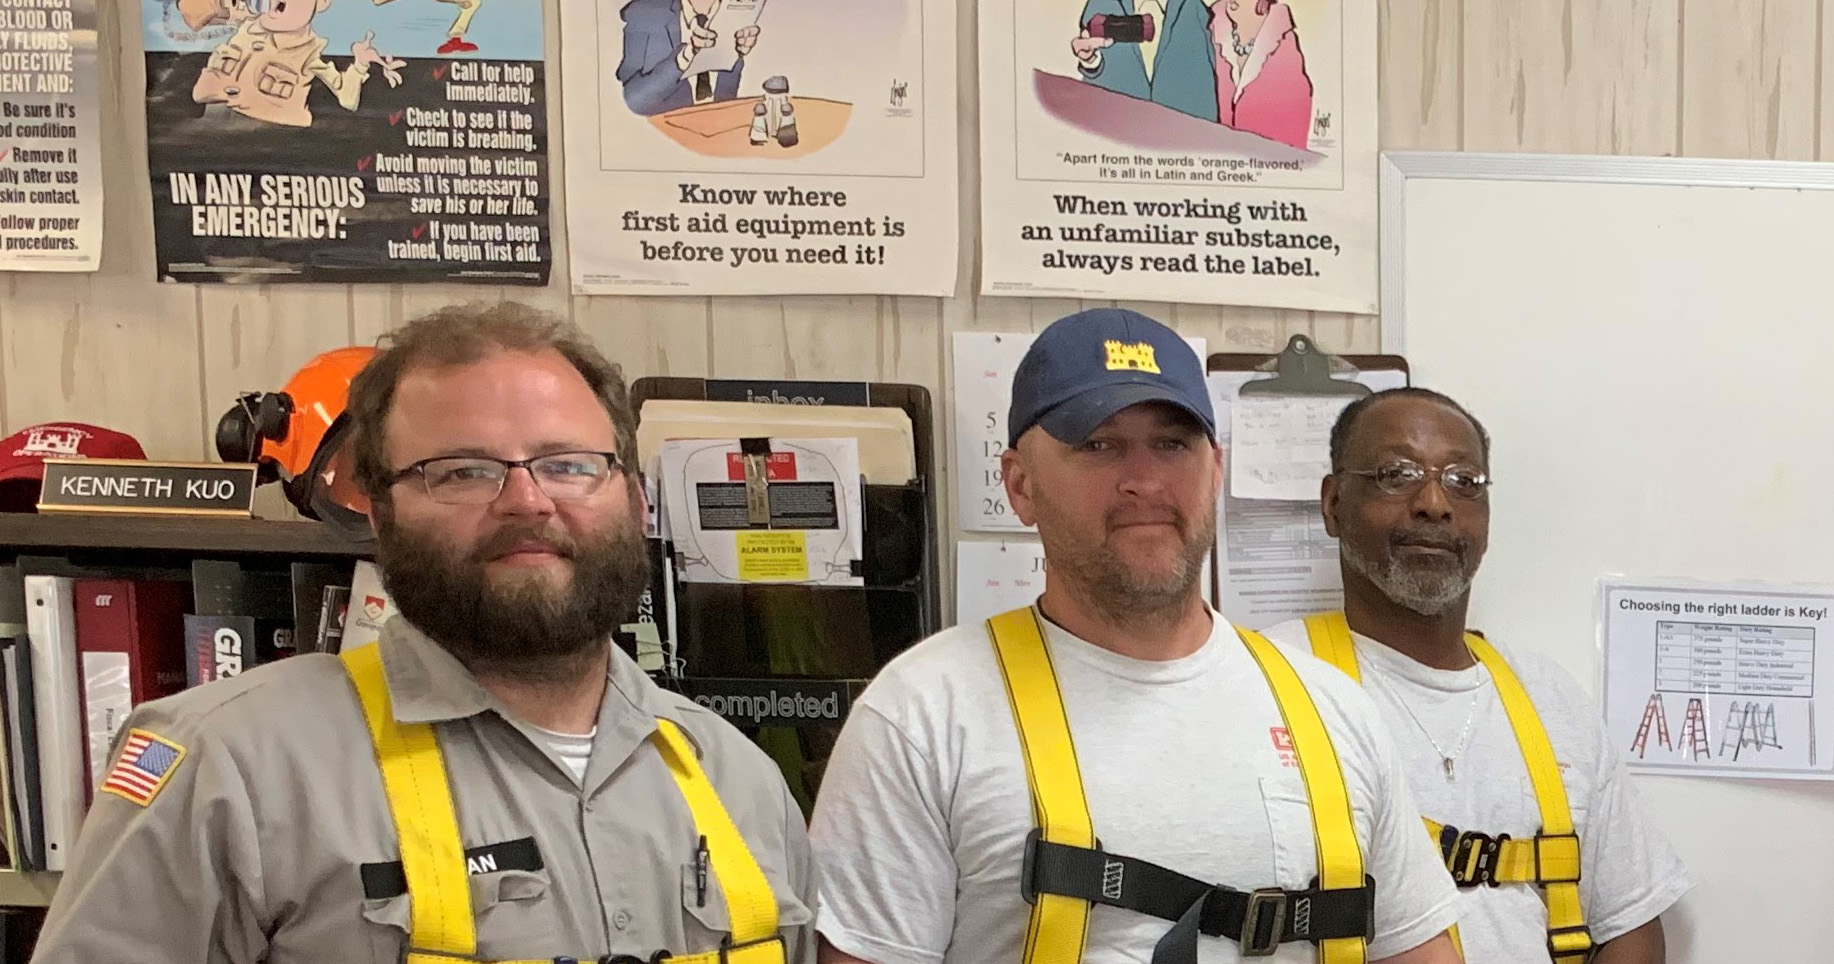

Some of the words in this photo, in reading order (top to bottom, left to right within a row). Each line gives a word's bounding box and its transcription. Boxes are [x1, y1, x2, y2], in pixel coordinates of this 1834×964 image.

[451, 62, 478, 81] Call
[481, 63, 501, 86] for
[504, 63, 534, 88] help
[446, 82, 535, 104] immediately.
[406, 107, 449, 127] Check
[452, 109, 466, 128] to
[469, 112, 494, 129] see
[497, 110, 507, 129] if
[510, 111, 533, 130] the
[406, 128, 449, 147] victim
[452, 129, 465, 148] is
[468, 130, 537, 151] breathing.
[375, 154, 414, 176] Avoid
[417, 156, 467, 177] moving
[469, 156, 492, 175] the
[494, 157, 538, 176] victim
[1099, 167, 1117, 178] it's
[1121, 168, 1136, 179] all
[1139, 169, 1151, 179] in
[1155, 169, 1186, 180] Latin
[1189, 170, 1213, 181] and
[170, 173, 198, 204] IN
[205, 174, 252, 208] ANY
[260, 175, 365, 208] SERIOUS
[678, 184, 757, 205] Know
[763, 186, 847, 207] where
[1053, 195, 1128, 215] When
[1133, 199, 1242, 225] working
[1247, 201, 1308, 222] with
[192, 206, 347, 238] EMERGENCY:
[429, 221, 439, 244] If
[442, 224, 467, 244] you
[467, 222, 503, 244] have
[505, 223, 540, 244] been
[621, 211, 680, 232] first
[687, 212, 729, 233] aid
[735, 214, 876, 239] equipment
[882, 216, 905, 237] is
[6, 236, 79, 250] procedures.
[1021, 225, 1053, 241] an
[1059, 224, 1199, 245] unfamiliar
[1205, 228, 1340, 254] substance,
[388, 240, 440, 261] trained,
[443, 240, 482, 262] begin
[484, 242, 513, 261] first
[515, 240, 541, 262] aid.
[640, 241, 724, 262] before
[730, 247, 779, 268] you
[785, 245, 848, 264] need
[855, 244, 885, 265] it!
[1042, 250, 1133, 275] always
[1140, 254, 1199, 272] read
[1204, 254, 1245, 274] the
[1252, 256, 1320, 276] label.
[986, 412, 996, 428] 5
[984, 441, 1002, 457] 12
[61, 476, 173, 498] KENNETH
[185, 480, 235, 499] KUO
[984, 498, 1004, 515] 26
[1619, 599, 1681, 615] Choosing
[1684, 602, 1705, 613] the
[1708, 603, 1737, 617] right
[1741, 604, 1781, 616] ladder
[1784, 606, 1795, 617] is
[1799, 607, 1827, 621] Key!
